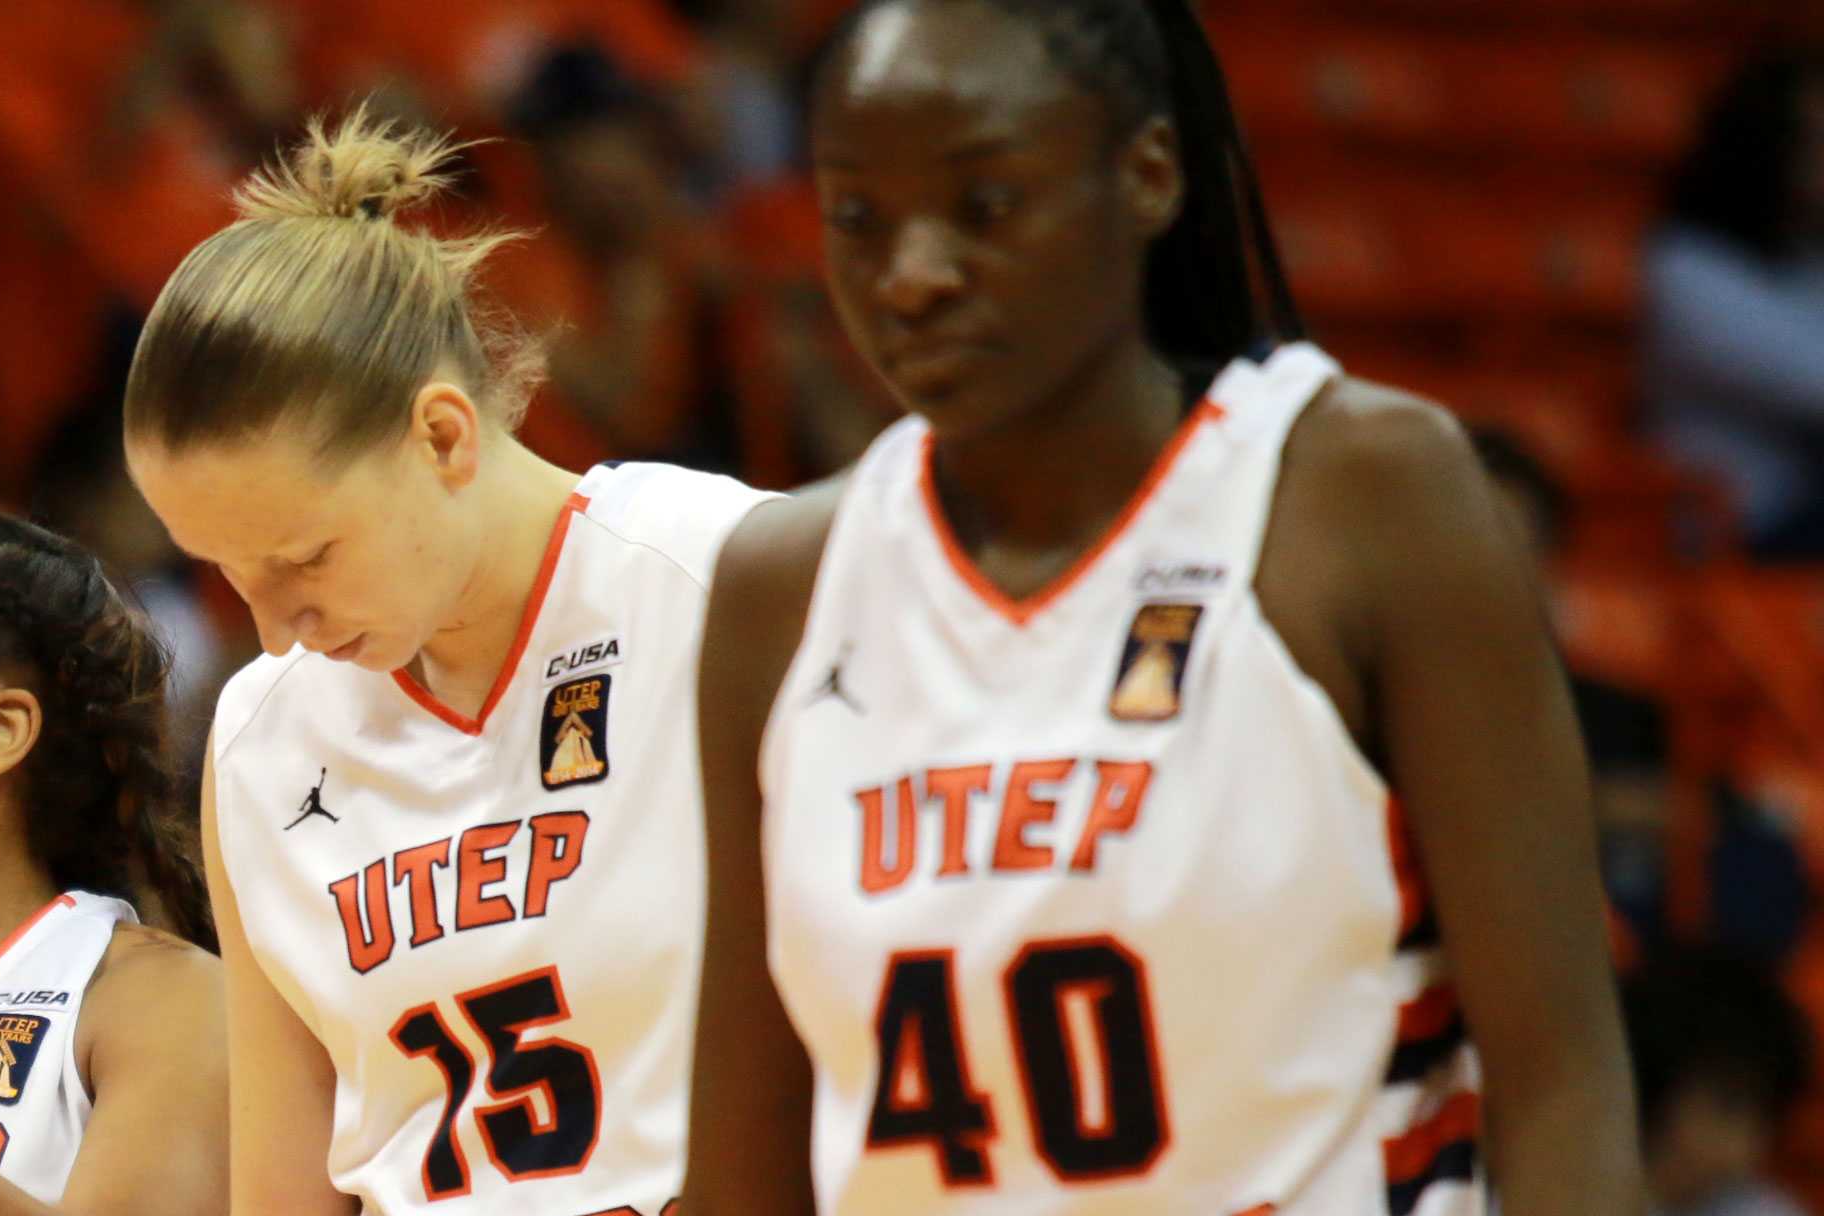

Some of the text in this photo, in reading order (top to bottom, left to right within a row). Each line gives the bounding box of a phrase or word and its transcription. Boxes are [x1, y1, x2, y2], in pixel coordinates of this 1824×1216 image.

[328, 810, 590, 976] UTEP
[852, 756, 1155, 898] UTEP
[387, 964, 603, 1202] 15
[864, 933, 1172, 1190] 40
